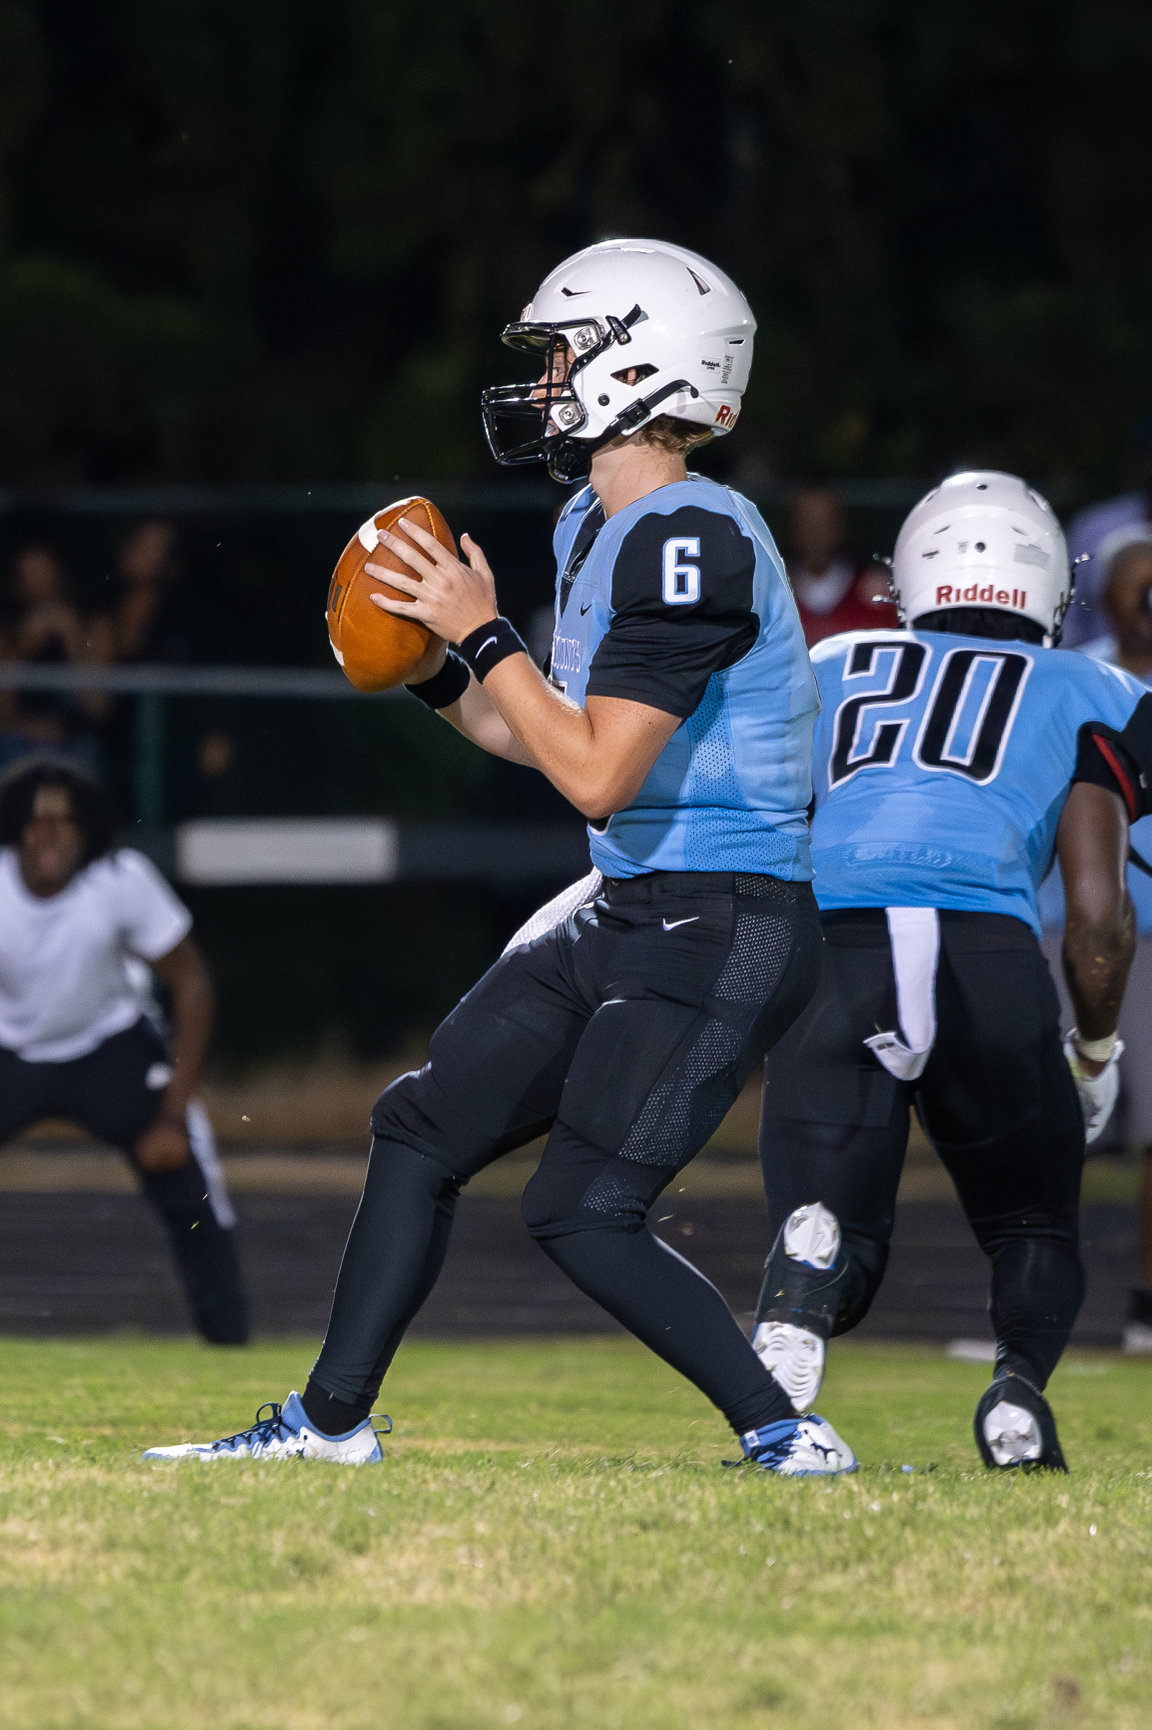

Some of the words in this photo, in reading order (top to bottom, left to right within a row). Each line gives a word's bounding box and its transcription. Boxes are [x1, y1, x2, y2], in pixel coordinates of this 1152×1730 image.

[662, 536, 701, 606] 6
[936, 583, 1027, 610] Riddell
[828, 640, 1035, 792] 20
